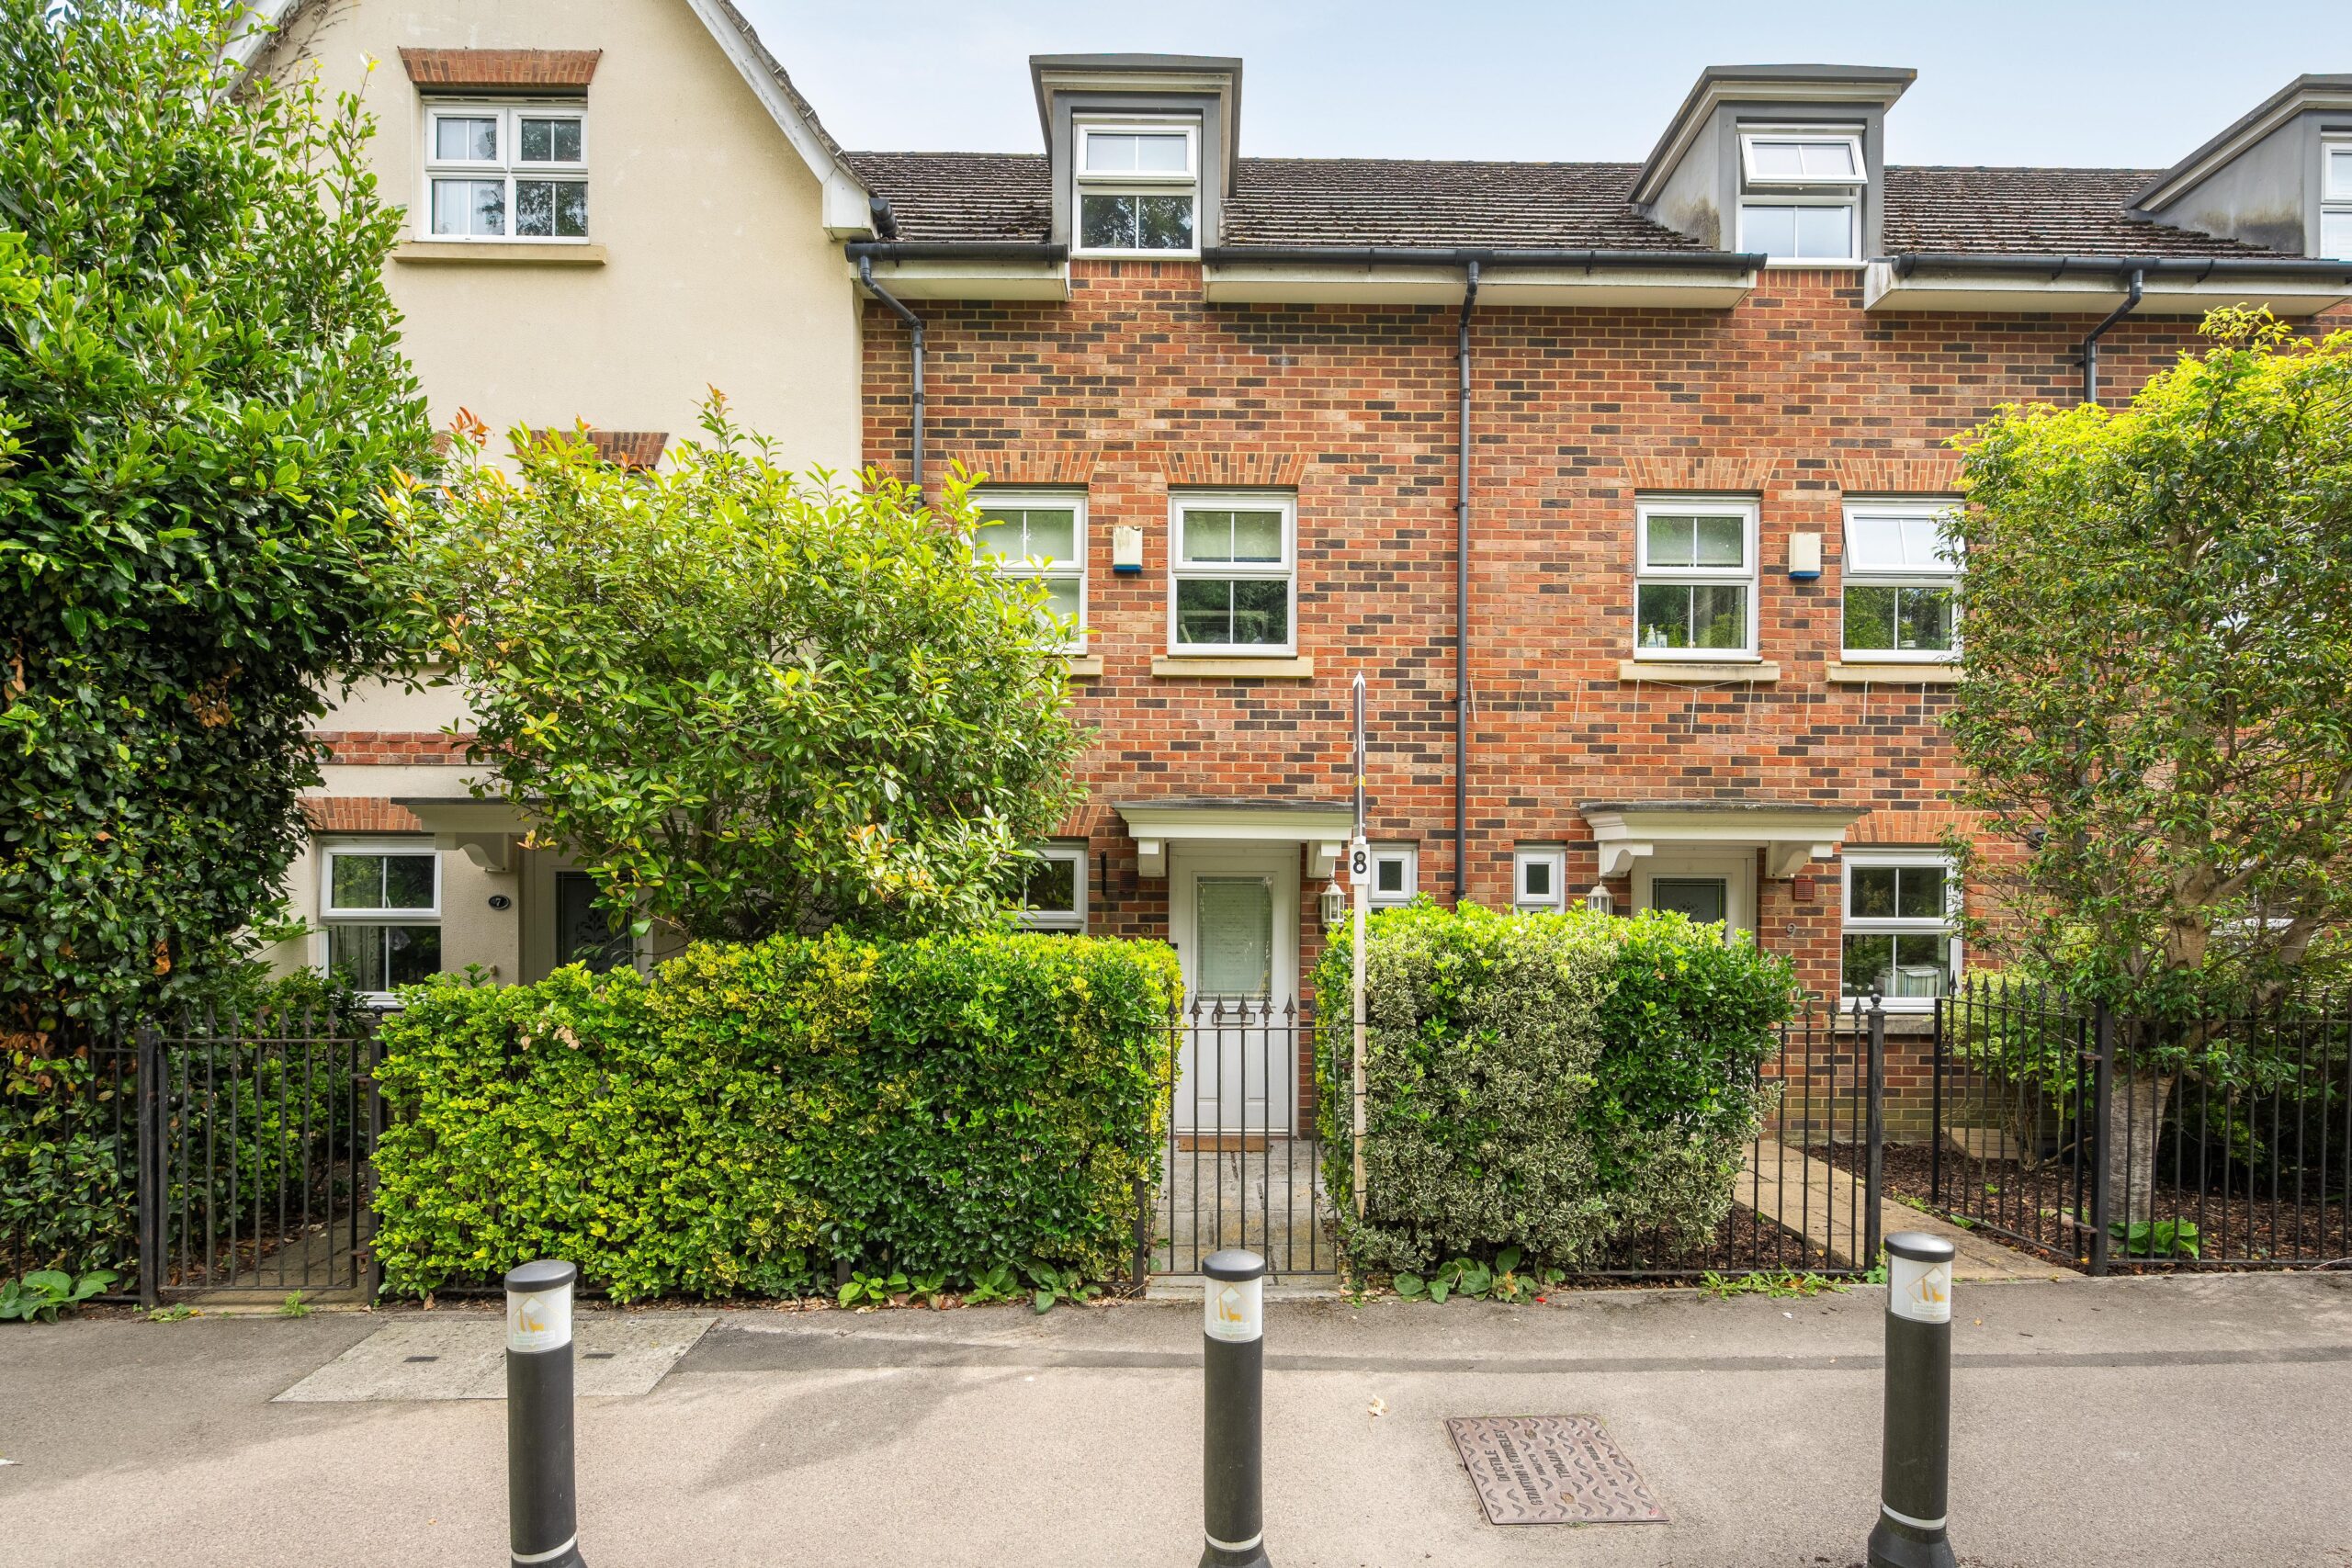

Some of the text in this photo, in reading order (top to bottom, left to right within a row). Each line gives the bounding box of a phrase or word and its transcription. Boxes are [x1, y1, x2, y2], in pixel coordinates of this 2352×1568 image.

[1352, 851, 1367, 874] 8
[1786, 922, 1797, 938] 9
[1493, 1428, 1521, 1463] STAVELEY
[1514, 1471, 1544, 1506] STANTON
